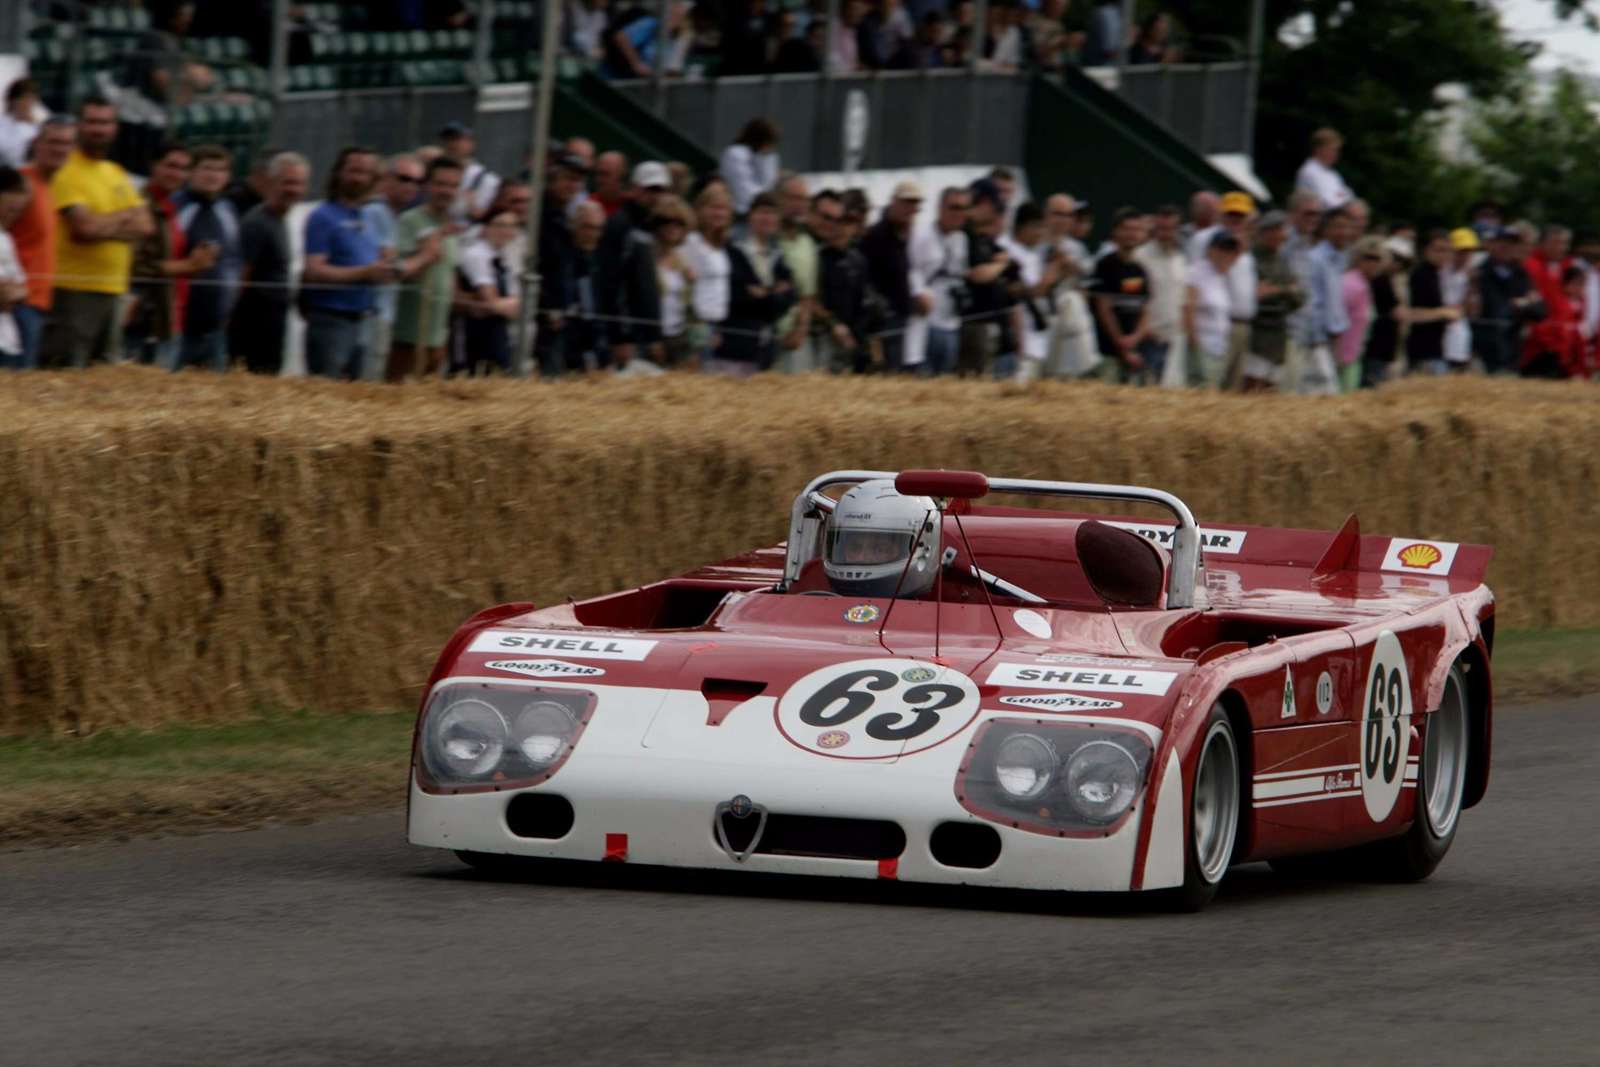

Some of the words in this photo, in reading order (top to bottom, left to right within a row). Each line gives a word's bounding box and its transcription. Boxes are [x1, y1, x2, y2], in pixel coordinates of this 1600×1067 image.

[499, 636, 623, 653] SHELL
[491, 661, 598, 675] GOODYEAR
[1016, 669, 1143, 687] SHELL
[799, 669, 966, 741] 63
[1005, 696, 1115, 708] GOODYEAR
[1365, 662, 1403, 784] 63
